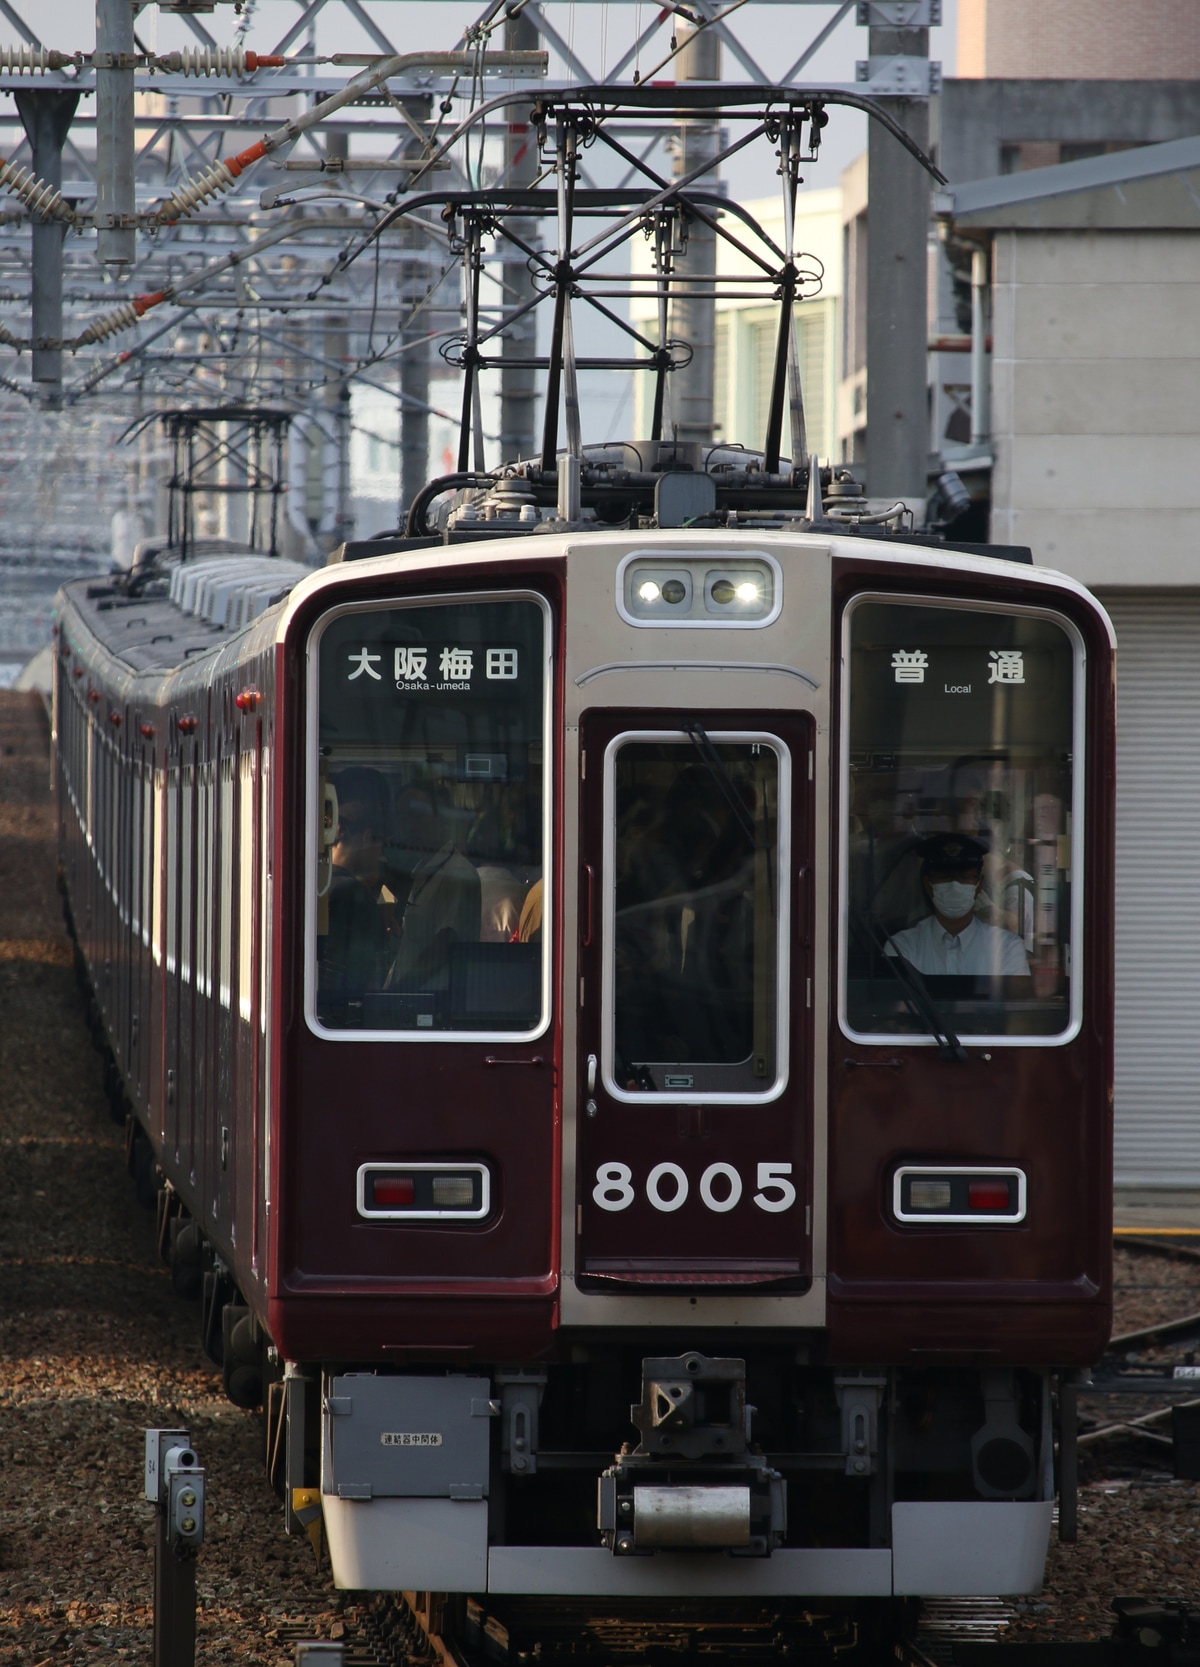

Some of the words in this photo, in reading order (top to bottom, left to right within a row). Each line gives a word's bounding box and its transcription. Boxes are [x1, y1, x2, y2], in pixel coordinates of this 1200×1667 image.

[347, 647, 518, 681] 大阪梅田
[890, 649, 1026, 684] 普通
[396, 681, 471, 691] Osaka-umeda
[944, 684, 972, 694] Local
[592, 1161, 796, 1213] 8005
